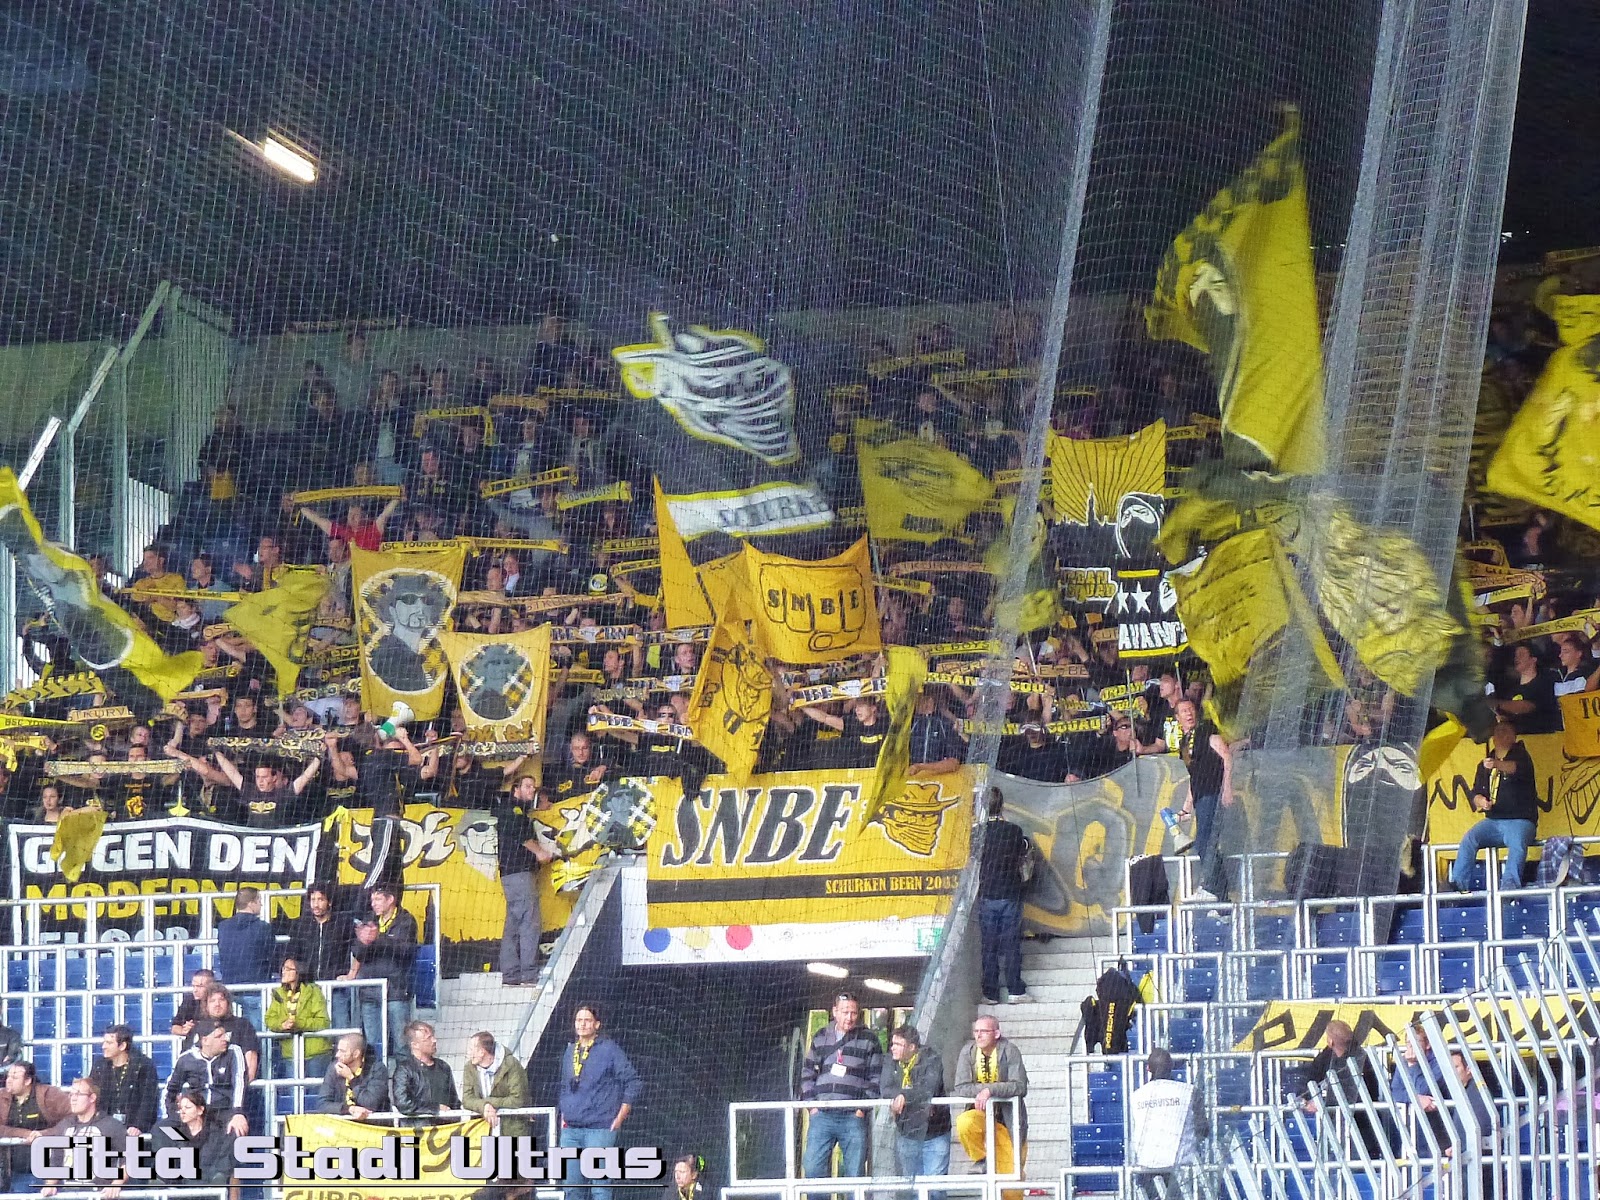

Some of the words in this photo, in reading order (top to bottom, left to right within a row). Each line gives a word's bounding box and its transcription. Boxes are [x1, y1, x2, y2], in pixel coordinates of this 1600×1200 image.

[661, 784, 861, 867] SNBE
[23, 830, 193, 875] GGEN
[208, 832, 310, 874] DEN
[26, 880, 302, 920] MODERNN
[825, 877, 887, 895] SCHURKEN
[889, 876, 923, 891] BERN
[1137, 1096, 1181, 1111] SUPERVISOR
